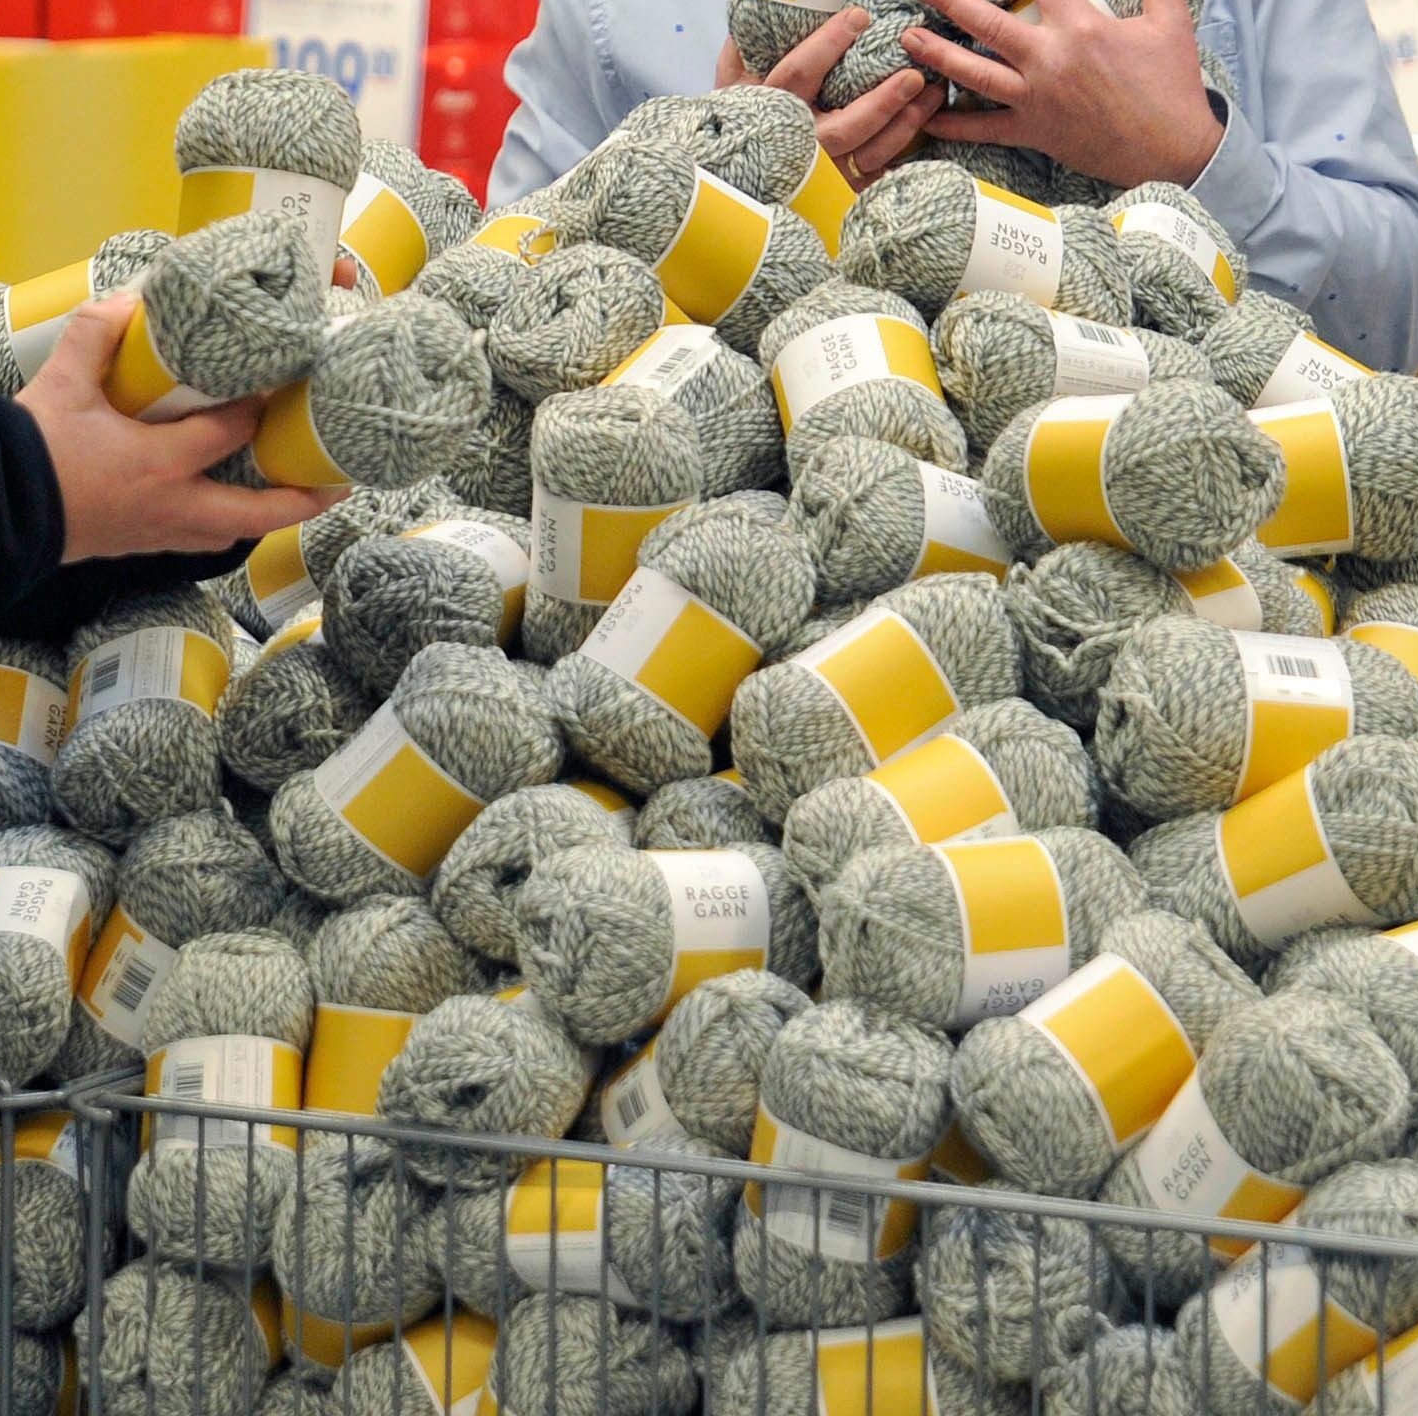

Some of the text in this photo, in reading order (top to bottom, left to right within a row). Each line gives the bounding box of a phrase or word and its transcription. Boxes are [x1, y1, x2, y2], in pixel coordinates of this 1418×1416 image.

[990, 232, 1048, 265] RAGGE
[997, 222, 1043, 248] GARN
[821, 333, 844, 381] RAGGE
[838, 332, 858, 370] GARN
[1296, 363, 1333, 390] GGE
[1309, 359, 1345, 382] ARN
[546, 518, 557, 573] GARN
[45, 703, 60, 749] GARN
[9, 881, 36, 916] GARN
[22, 880, 53, 923] RAGGE
[684, 884, 750, 902] RAGGE
[694, 902, 748, 918] GARN
[1160, 1131, 1205, 1193] RAGGE
[1175, 1152, 1212, 1201] GARN
